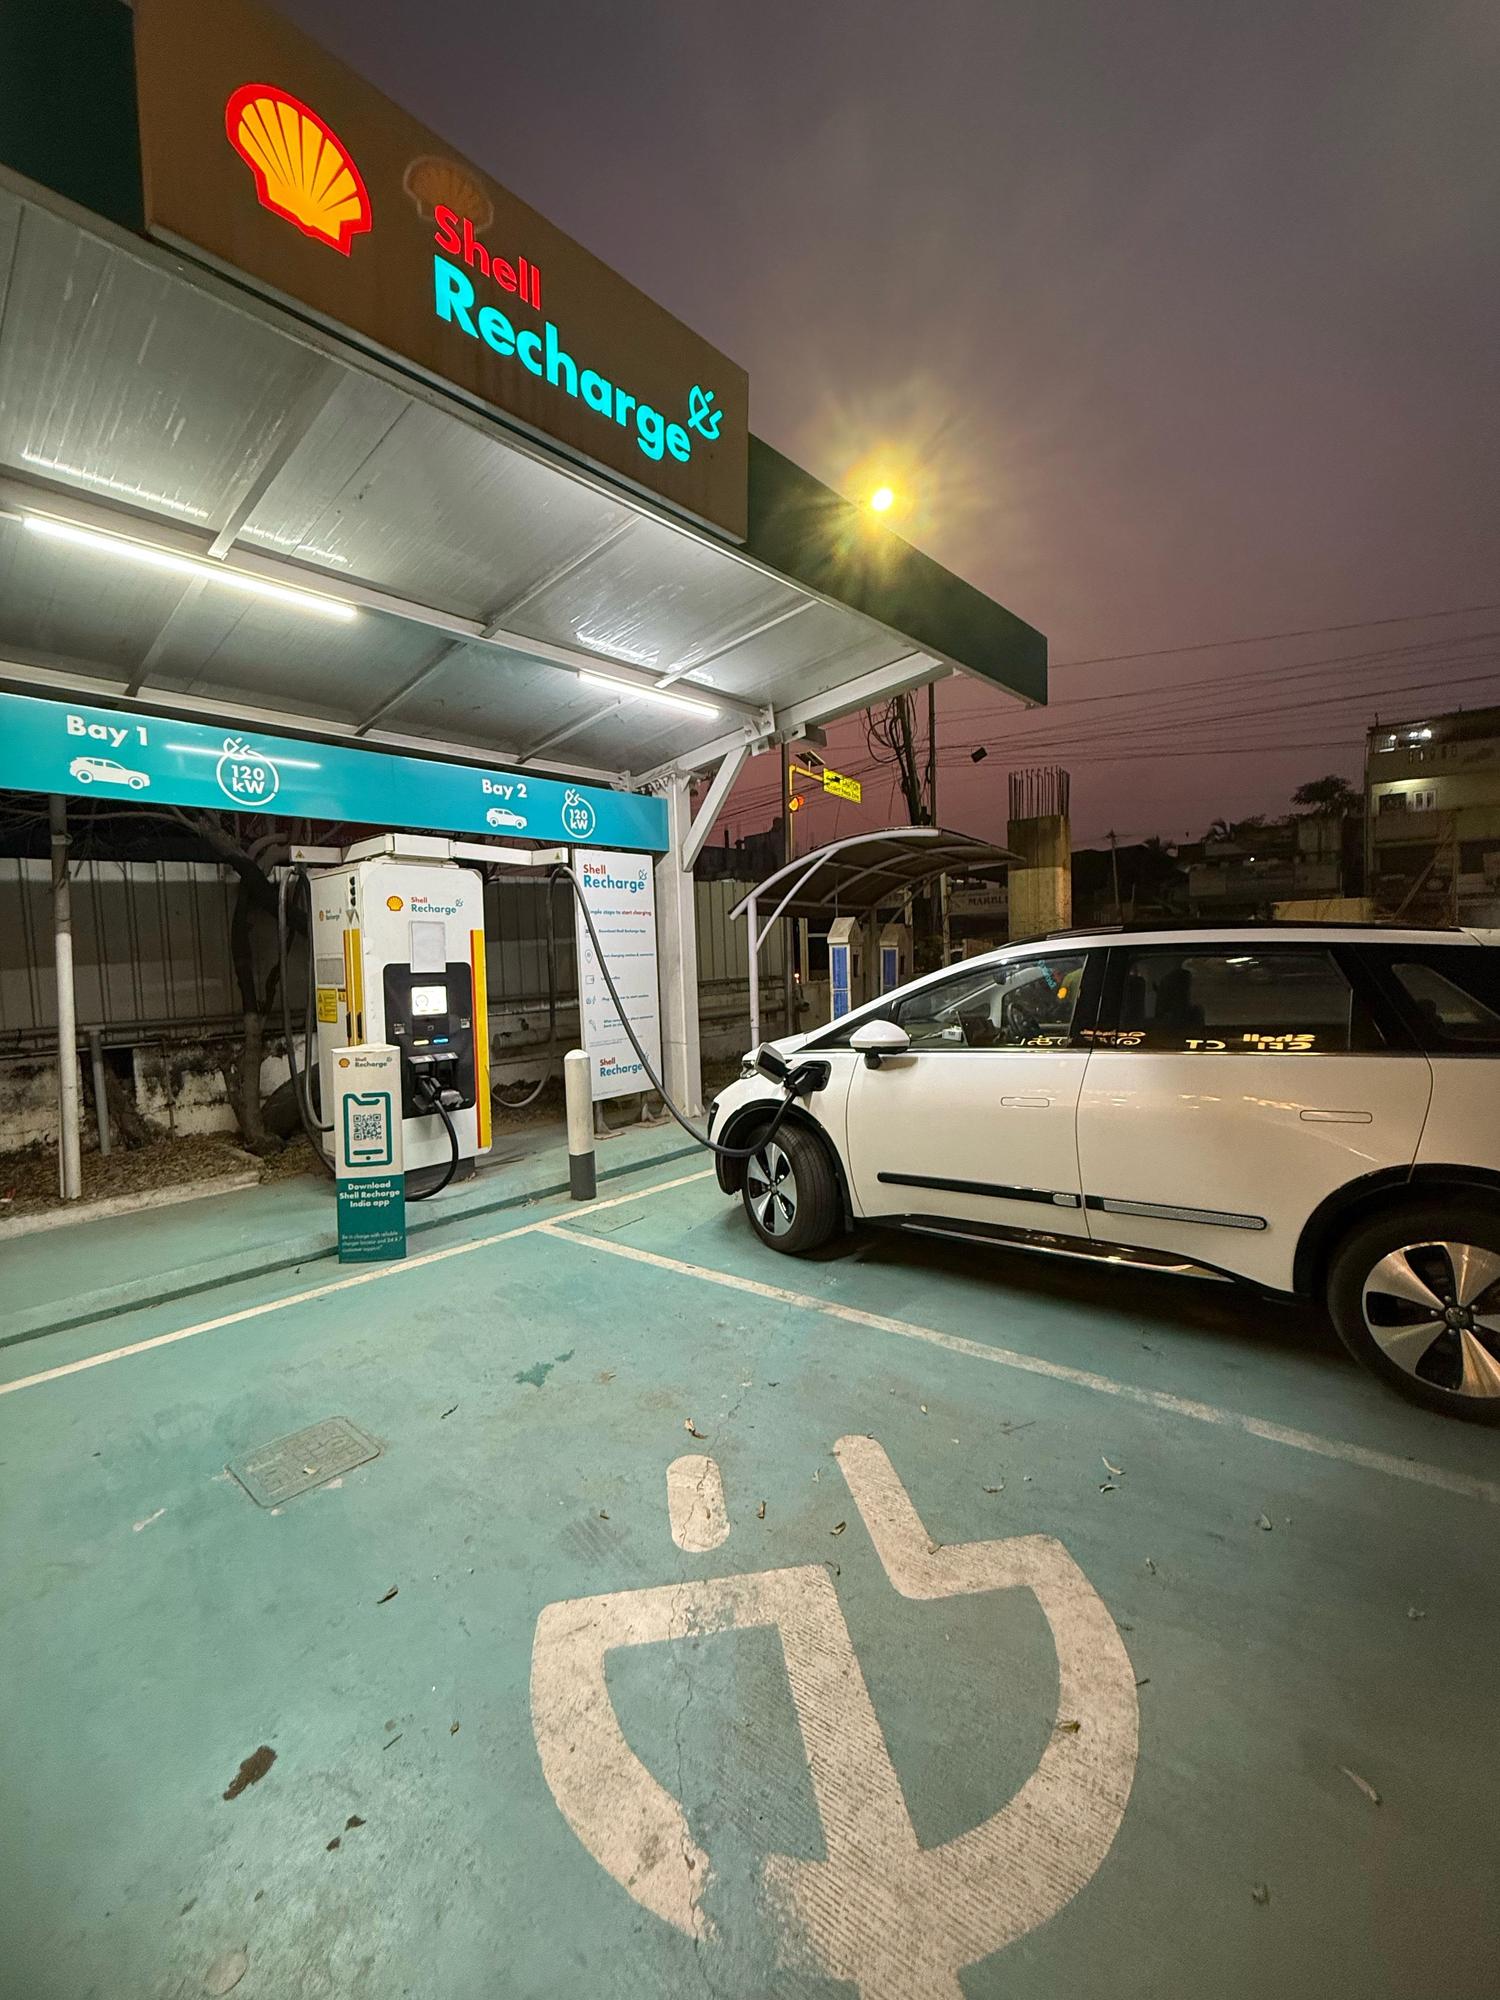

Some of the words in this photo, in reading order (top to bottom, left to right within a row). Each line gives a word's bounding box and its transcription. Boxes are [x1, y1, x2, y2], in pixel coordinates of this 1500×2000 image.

[433, 204, 542, 311] Shell
[433, 254, 692, 463] Recharge
[66, 714, 129, 748] Bay
[136, 726, 148, 746] 1
[231, 764, 265, 781] 120
[232, 777, 265, 795] kW
[481, 778, 514, 800] Bay
[516, 783, 528, 798] 2
[569, 808, 588, 820] 120
[570, 818, 588, 830] kW
[583, 863, 607, 875] Shell
[583, 874, 645, 893] Recharge
[411, 896, 428, 904] Shell
[411, 903, 457, 916] Recharge
[599, 1057, 616, 1066] Shell
[600, 1063, 643, 1077] Recharge
[347, 1180, 391, 1191] Download
[339, 1191, 360, 1200] Shell
[361, 1190, 400, 1198] Recharge
[373, 1199, 390, 1208] app
